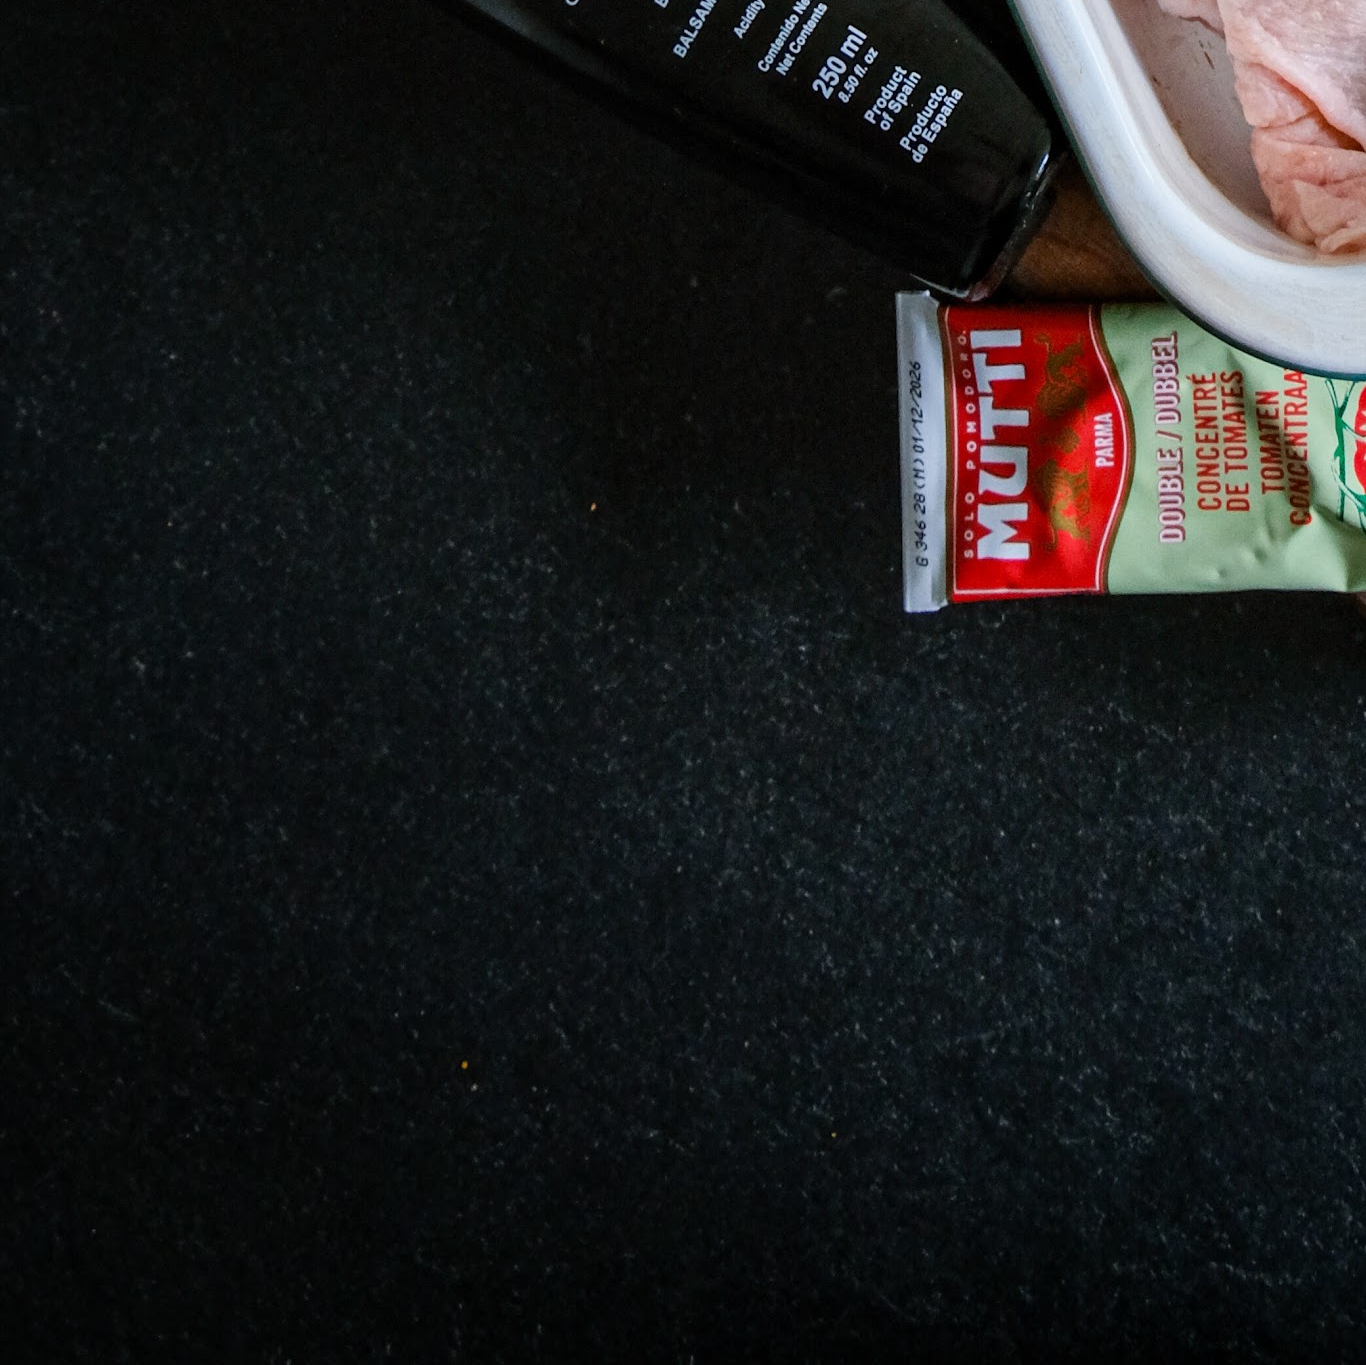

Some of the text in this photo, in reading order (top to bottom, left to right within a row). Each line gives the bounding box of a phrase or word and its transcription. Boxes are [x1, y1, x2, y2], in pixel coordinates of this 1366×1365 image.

[757, 14, 800, 73] Contenido
[775, 2, 828, 76] Net Contents
[812, 24, 868, 100] 250 ml
[838, 73, 861, 104] 8.50
[864, 46, 879, 66] oz
[864, 65, 907, 125] Product
[879, 70, 922, 132] of Spain
[899, 84, 947, 152] Producto
[911, 88, 964, 164] de España
[1151, 330, 1181, 425] DUBBEL
[969, 328, 1031, 561] MUTTI
[1093, 412, 1115, 468] PARMA
[1186, 371, 1222, 511] CONCENTRÉ
[1219, 370, 1250, 512] DE TOMATES
[1255, 390, 1285, 495] TOMATEN
[1283, 368, 1312, 526] CONCENTRAA
[963, 491, 976, 559] SOLO
[1157, 446, 1187, 544] DOUBLE
